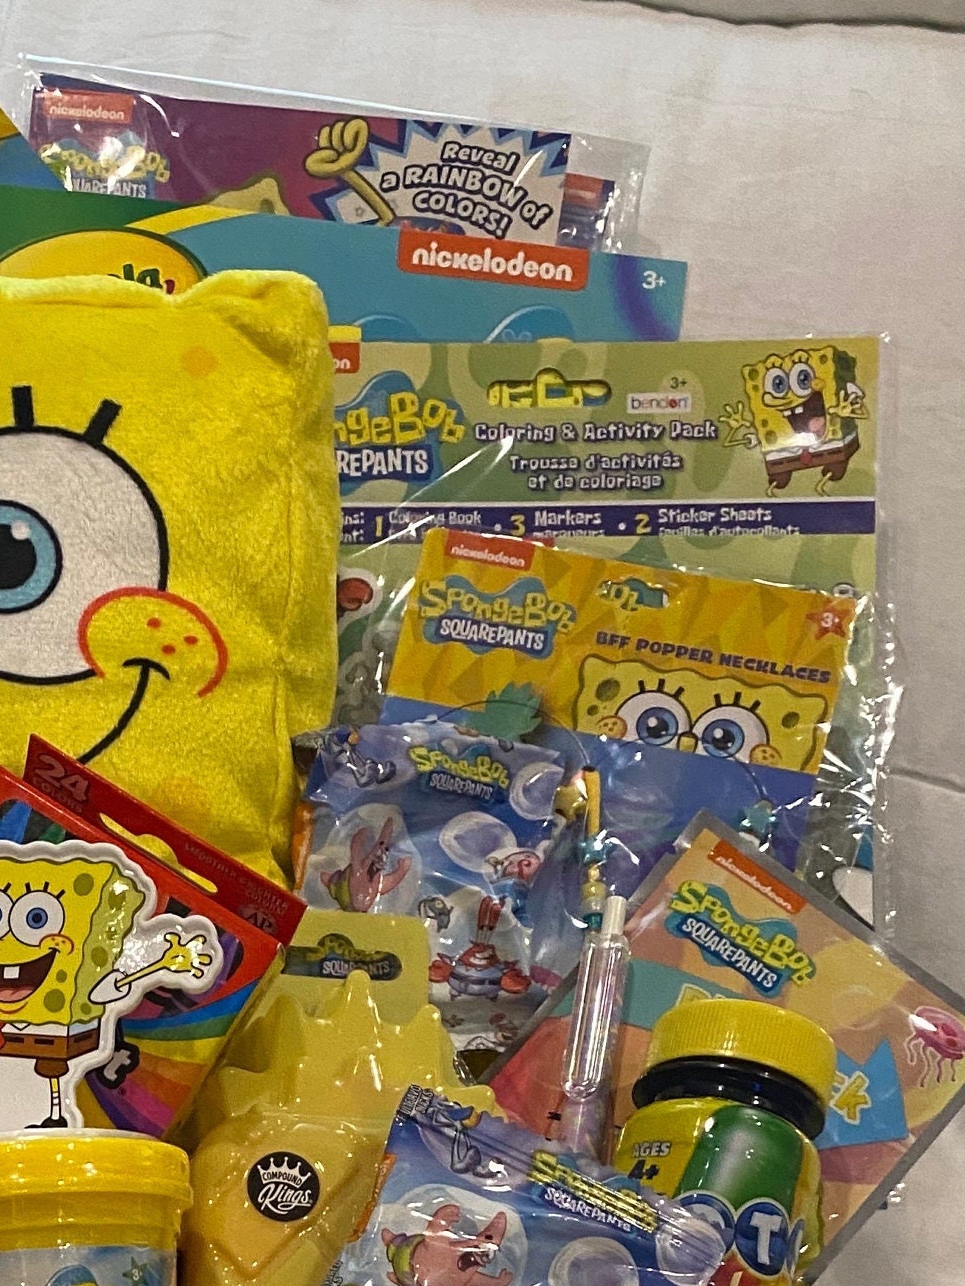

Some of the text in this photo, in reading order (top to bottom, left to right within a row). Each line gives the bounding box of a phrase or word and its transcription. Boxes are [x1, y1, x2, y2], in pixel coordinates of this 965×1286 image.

[49, 104, 125, 121] nickelodeon
[443, 141, 518, 173] Reveal
[382, 166, 551, 229] a RAINBOW of
[414, 192, 512, 238] COLORS!
[412, 242, 573, 282] nickelodeon
[642, 269, 667, 289] 3+
[669, 377, 688, 390] 3+
[630, 395, 689, 410] bendon
[474, 419, 718, 443] Coloring & Activity Pack
[509, 454, 579, 471] Trousse
[527, 473, 663, 491] et de coloriage
[448, 510, 482, 526] Book
[510, 514, 526, 537] 3
[534, 510, 602, 527] Markers
[634, 513, 652, 535] 2
[658, 508, 716, 524] Sticker
[720, 507, 772, 523] Sheets
[450, 543, 526, 568] nickelodeon
[420, 579, 576, 634] SpongeBob
[440, 618, 545, 651] SQUAREPANTS
[595, 631, 832, 685] BFF POPPER NECKLACES
[34, 753, 89, 802] 24
[429, 772, 493, 800] SQUAREPANTS
[715, 855, 793, 911] nickelodeon
[671, 880, 813, 988] SpongeBob
[682, 918, 778, 988] SQUAREPANTS
[632, 1141, 671, 1158] AGES
[262, 1171, 303, 1186] COMPOUND
[257, 1182, 312, 1215] Kings
